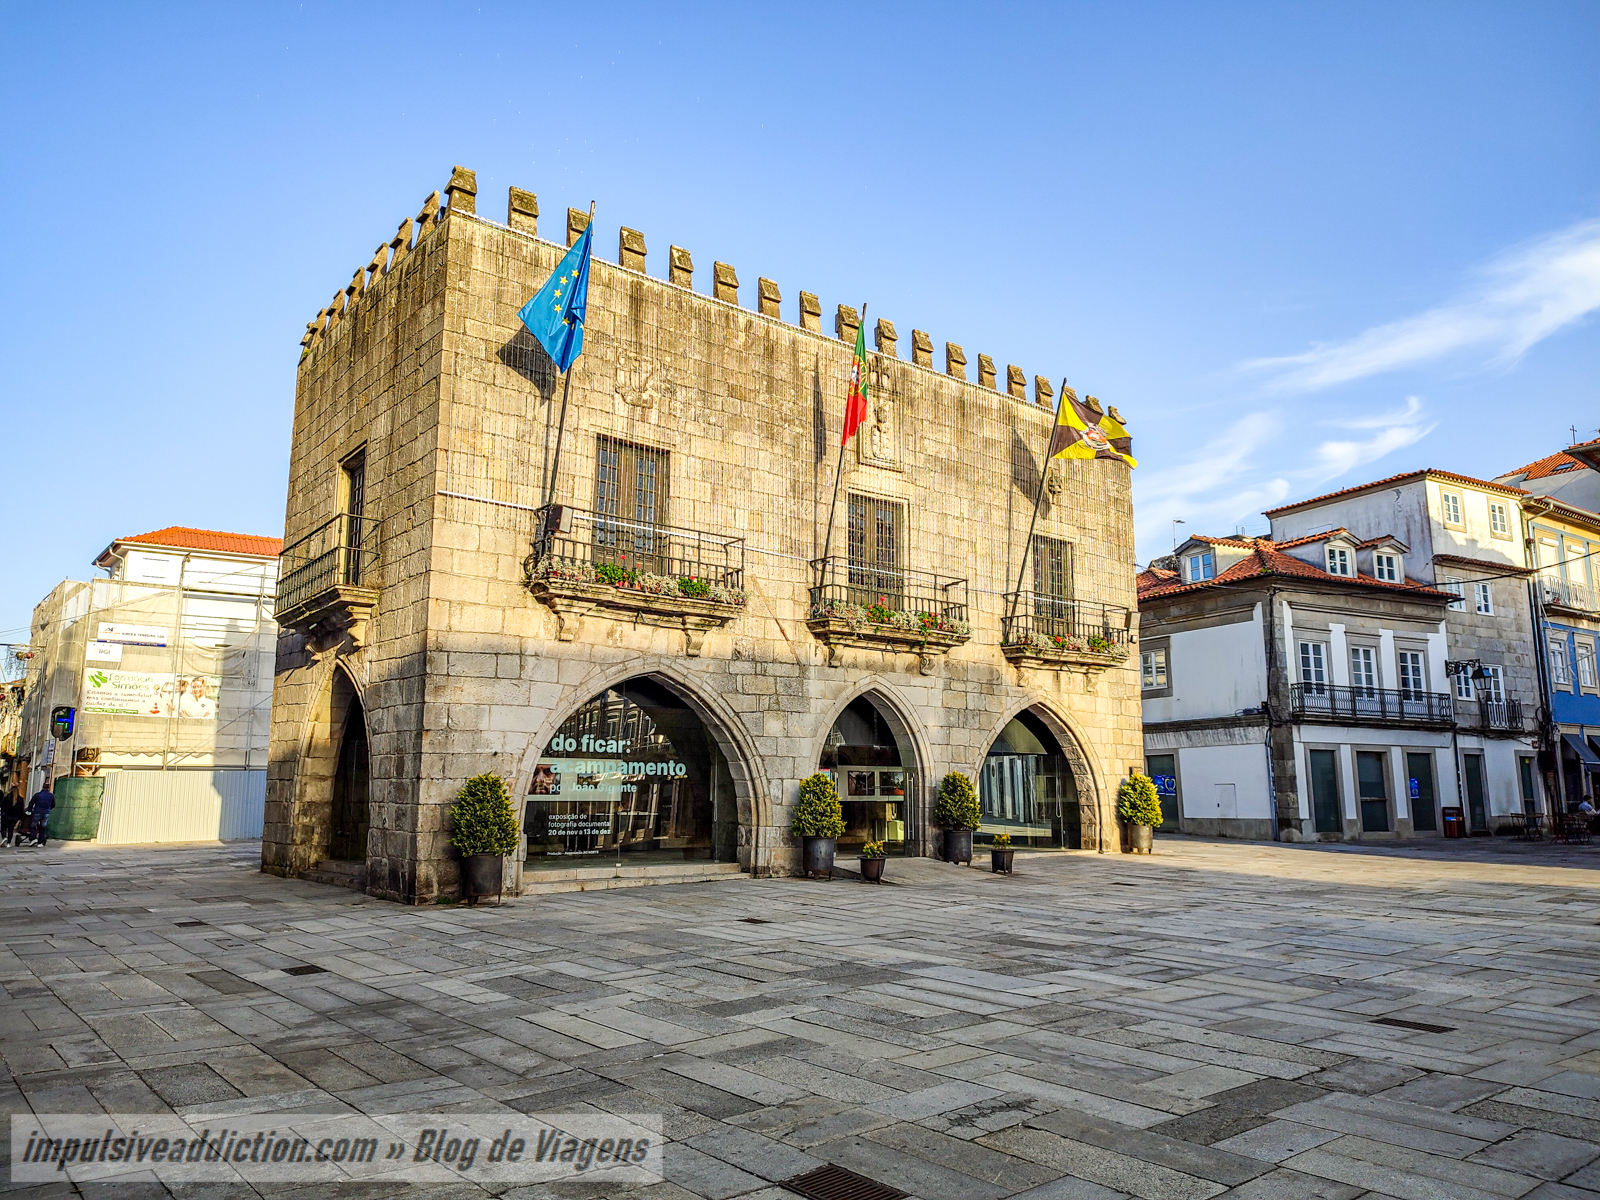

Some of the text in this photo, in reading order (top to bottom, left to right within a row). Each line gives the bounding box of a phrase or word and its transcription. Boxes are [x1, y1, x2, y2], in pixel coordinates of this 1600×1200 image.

[109, 672, 154, 683] Farmácia
[112, 681, 150, 691] Simões
[551, 733, 631, 754] do ficar:
[549, 759, 687, 776] acampamento
[570, 782, 595, 793] João
[596, 782, 637, 794] Gigante
[548, 813, 579, 821] exposição
[548, 820, 612, 828] fotografia documental
